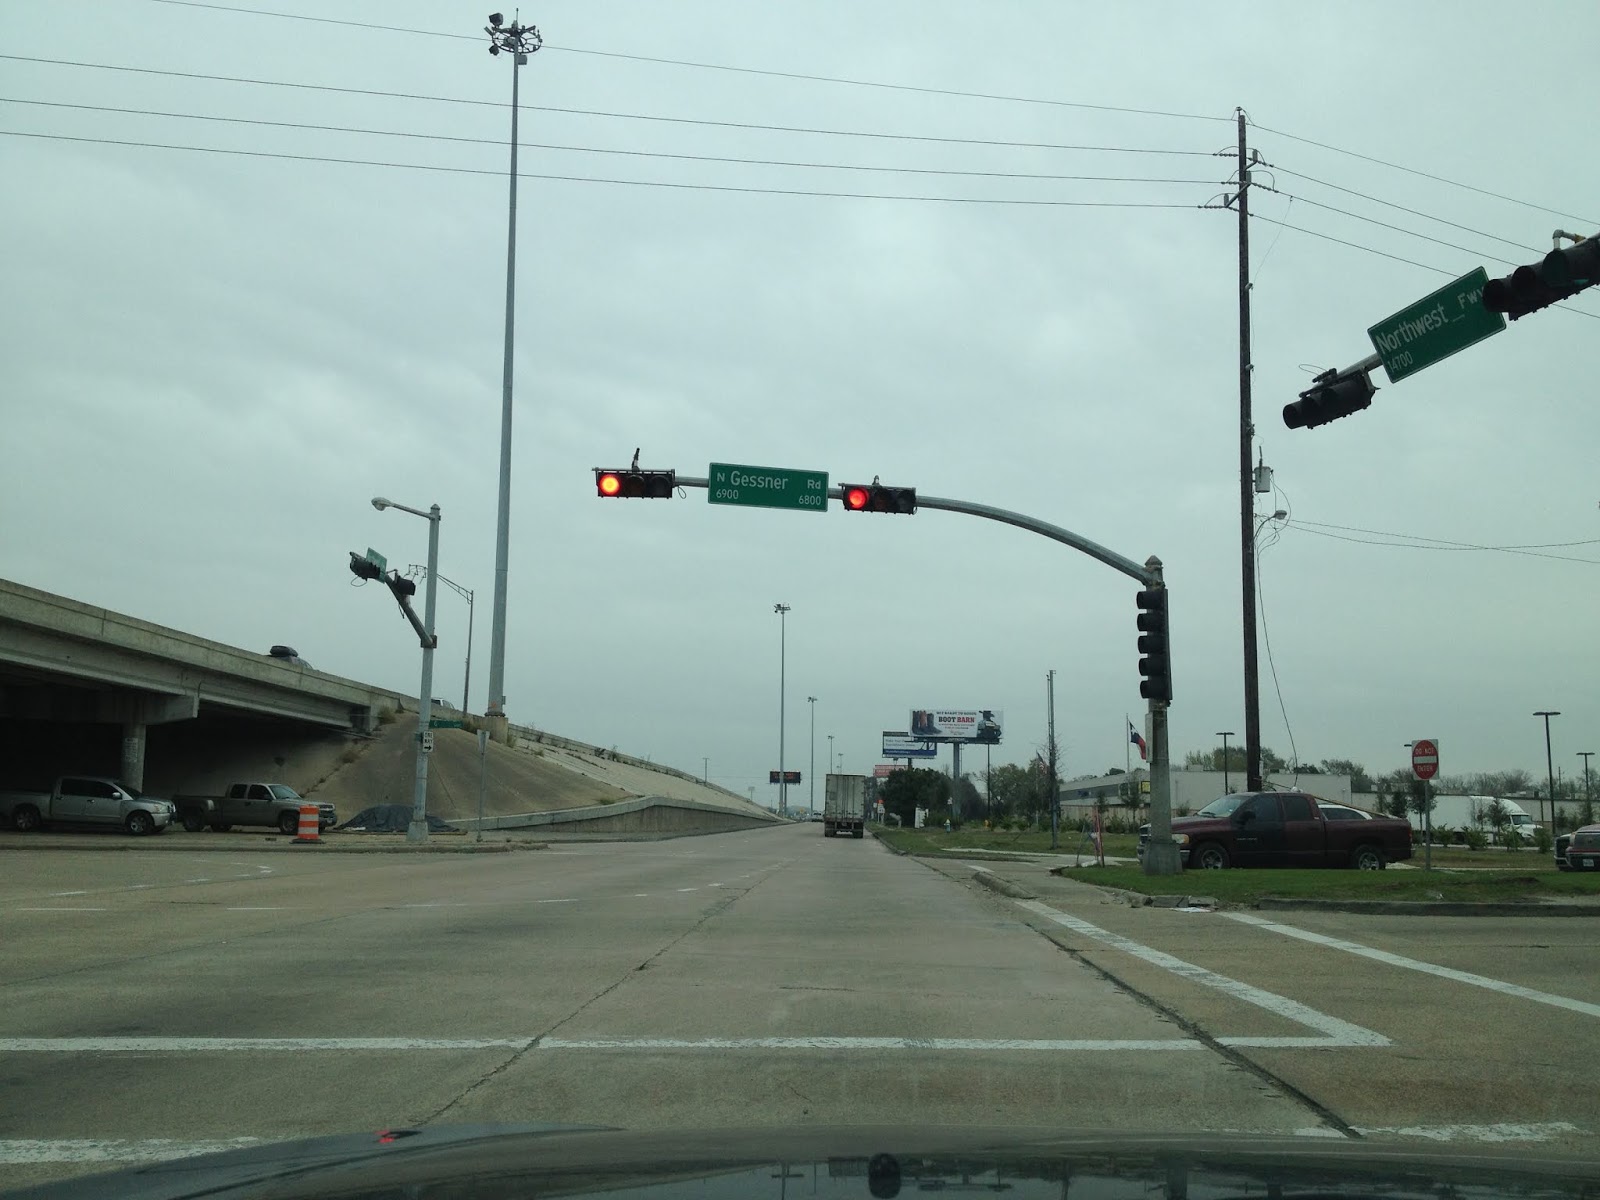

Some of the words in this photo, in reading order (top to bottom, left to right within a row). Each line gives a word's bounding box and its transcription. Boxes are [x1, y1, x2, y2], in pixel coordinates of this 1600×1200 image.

[1376, 303, 1449, 355] Northwest
[1387, 351, 1413, 373] 14700
[716, 472, 725, 482] N
[730, 470, 788, 490] Gessner
[807, 479, 821, 490] Rd
[716, 488, 739, 500] 6900
[798, 495, 822, 506] 6800
[1424, 747, 1434, 755] NOT
